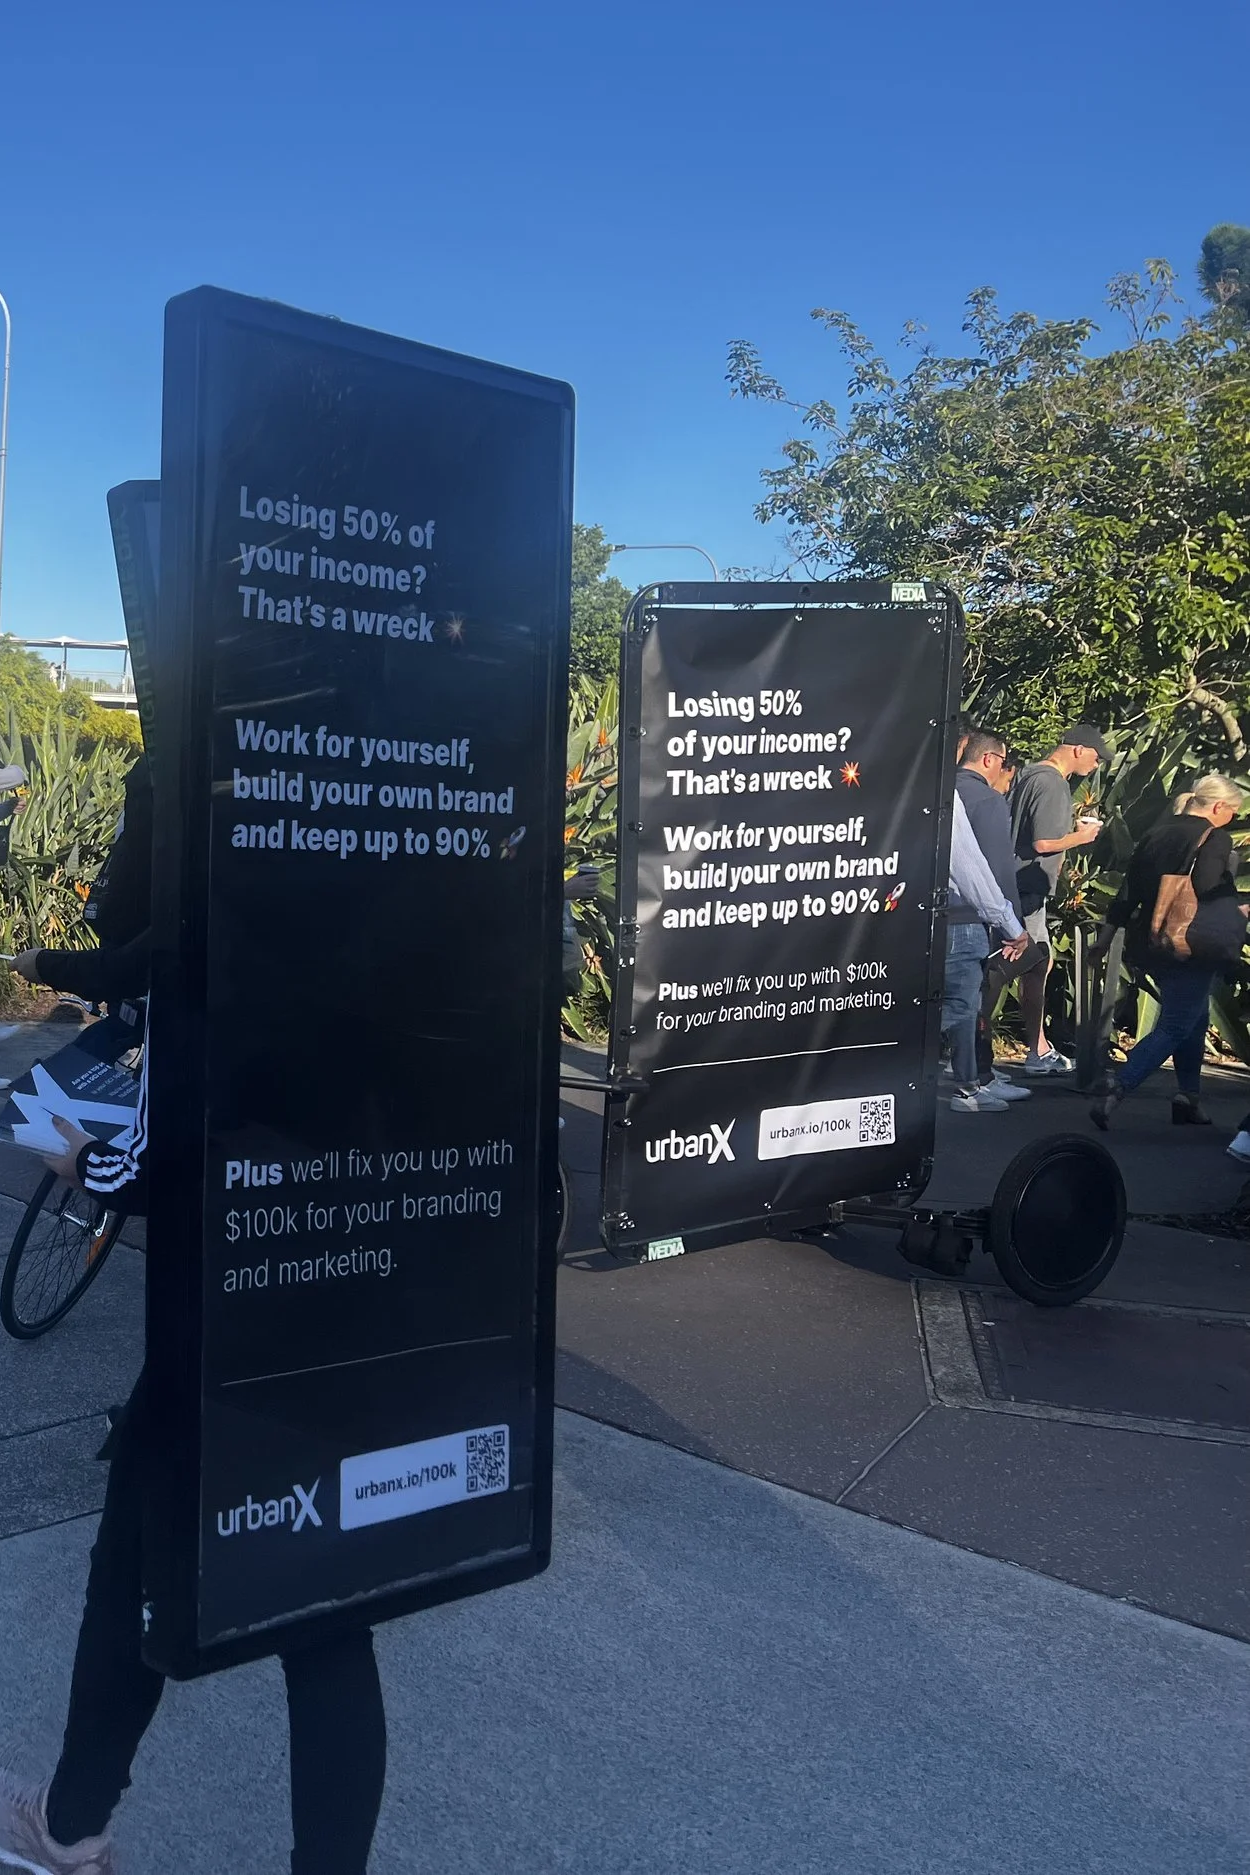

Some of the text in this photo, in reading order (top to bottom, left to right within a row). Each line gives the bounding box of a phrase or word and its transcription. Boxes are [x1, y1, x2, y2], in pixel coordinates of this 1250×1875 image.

[240, 486, 435, 549] Losing 50% of
[239, 542, 426, 594] your income?
[238, 585, 434, 642] That's a wreck
[892, 587, 927, 601] MEDIA
[668, 689, 802, 722] Losing 50%
[236, 719, 474, 774] Work for yourself,
[667, 727, 851, 762] of your income?
[233, 768, 513, 814] build your own brand
[667, 765, 832, 795] That's a wreck
[232, 819, 490, 860] and keep up to 90%
[664, 816, 866, 852] Work for yourself,
[663, 852, 898, 892] build your own brand
[663, 888, 879, 928] and keep up to 90%
[659, 962, 887, 1001] Plus we'll fix you up with $100k
[656, 992, 895, 1032] for your branding and marketing.
[646, 1119, 735, 1164] urbanX
[770, 1120, 851, 1140] urbanx.io/100k
[226, 1139, 512, 1189] Plus we'll fix you up with
[226, 1187, 501, 1243] $100k for your branding
[224, 1246, 397, 1292] and marketing.
[648, 1241, 684, 1261] MEDIA
[355, 1462, 457, 1499] urbanx.io/100k
[218, 1478, 322, 1536] urbanX
